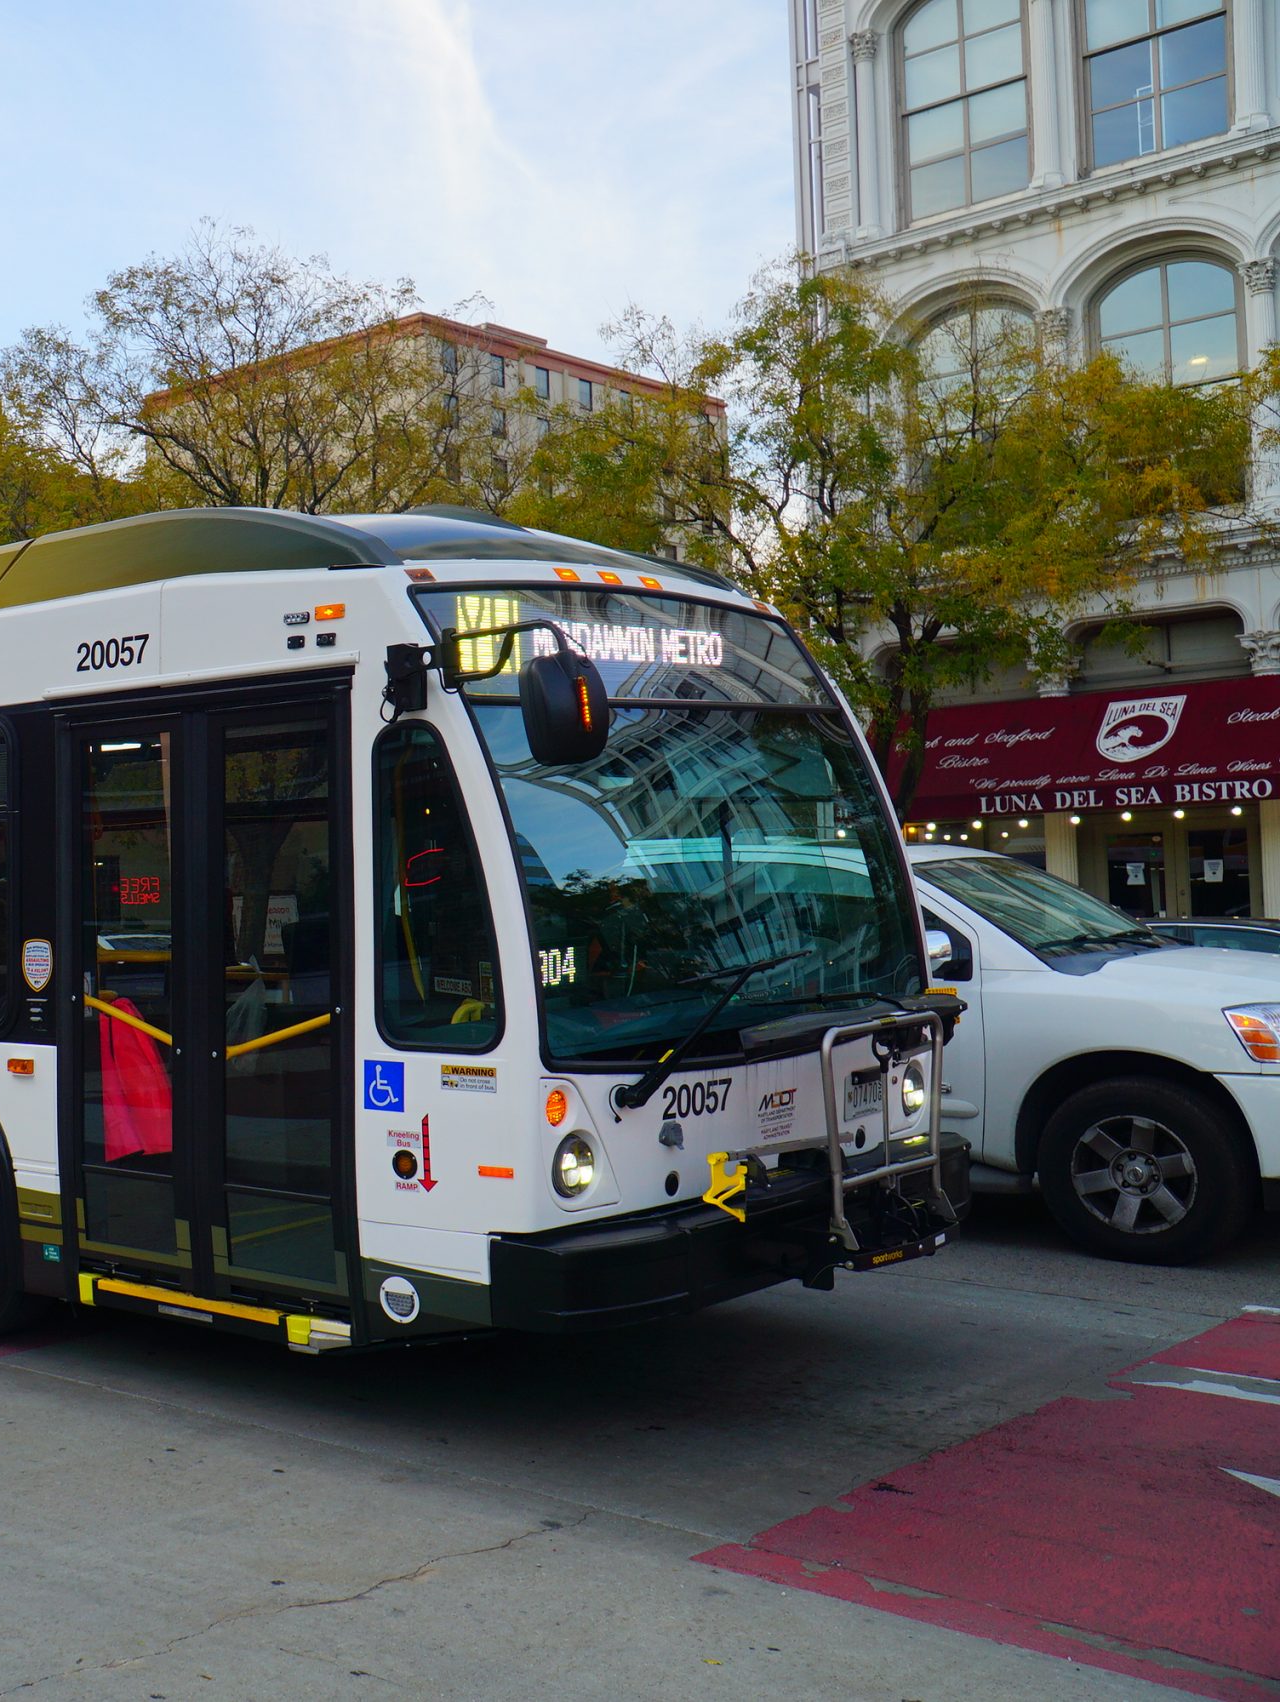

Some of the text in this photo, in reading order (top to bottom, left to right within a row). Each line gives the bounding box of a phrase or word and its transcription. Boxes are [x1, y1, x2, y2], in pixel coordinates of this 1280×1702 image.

[77, 633, 150, 672] 20057
[661, 627, 723, 666] METRO
[1106, 701, 1179, 727] LUNA DEL SEA
[944, 733, 980, 748] and
[984, 727, 1056, 748] Seafood
[936, 754, 990, 769] Bistro
[994, 774, 1052, 792] proudly
[1055, 775, 1090, 785] serve
[1094, 769, 1136, 782] Luna
[1142, 765, 1170, 779] Di
[1174, 763, 1217, 776] Luna
[1226, 759, 1272, 773] Wines
[979, 778, 1273, 814] LUNA DEL SEA BISTRO
[451, 1067, 494, 1077] WARNING
[662, 1077, 733, 1121] 20057
[388, 1129, 420, 1142] Kneeling
[396, 1139, 411, 1147] Bus
[396, 1182, 419, 1191] RAMP
[872, 1250, 903, 1265] sportworks
